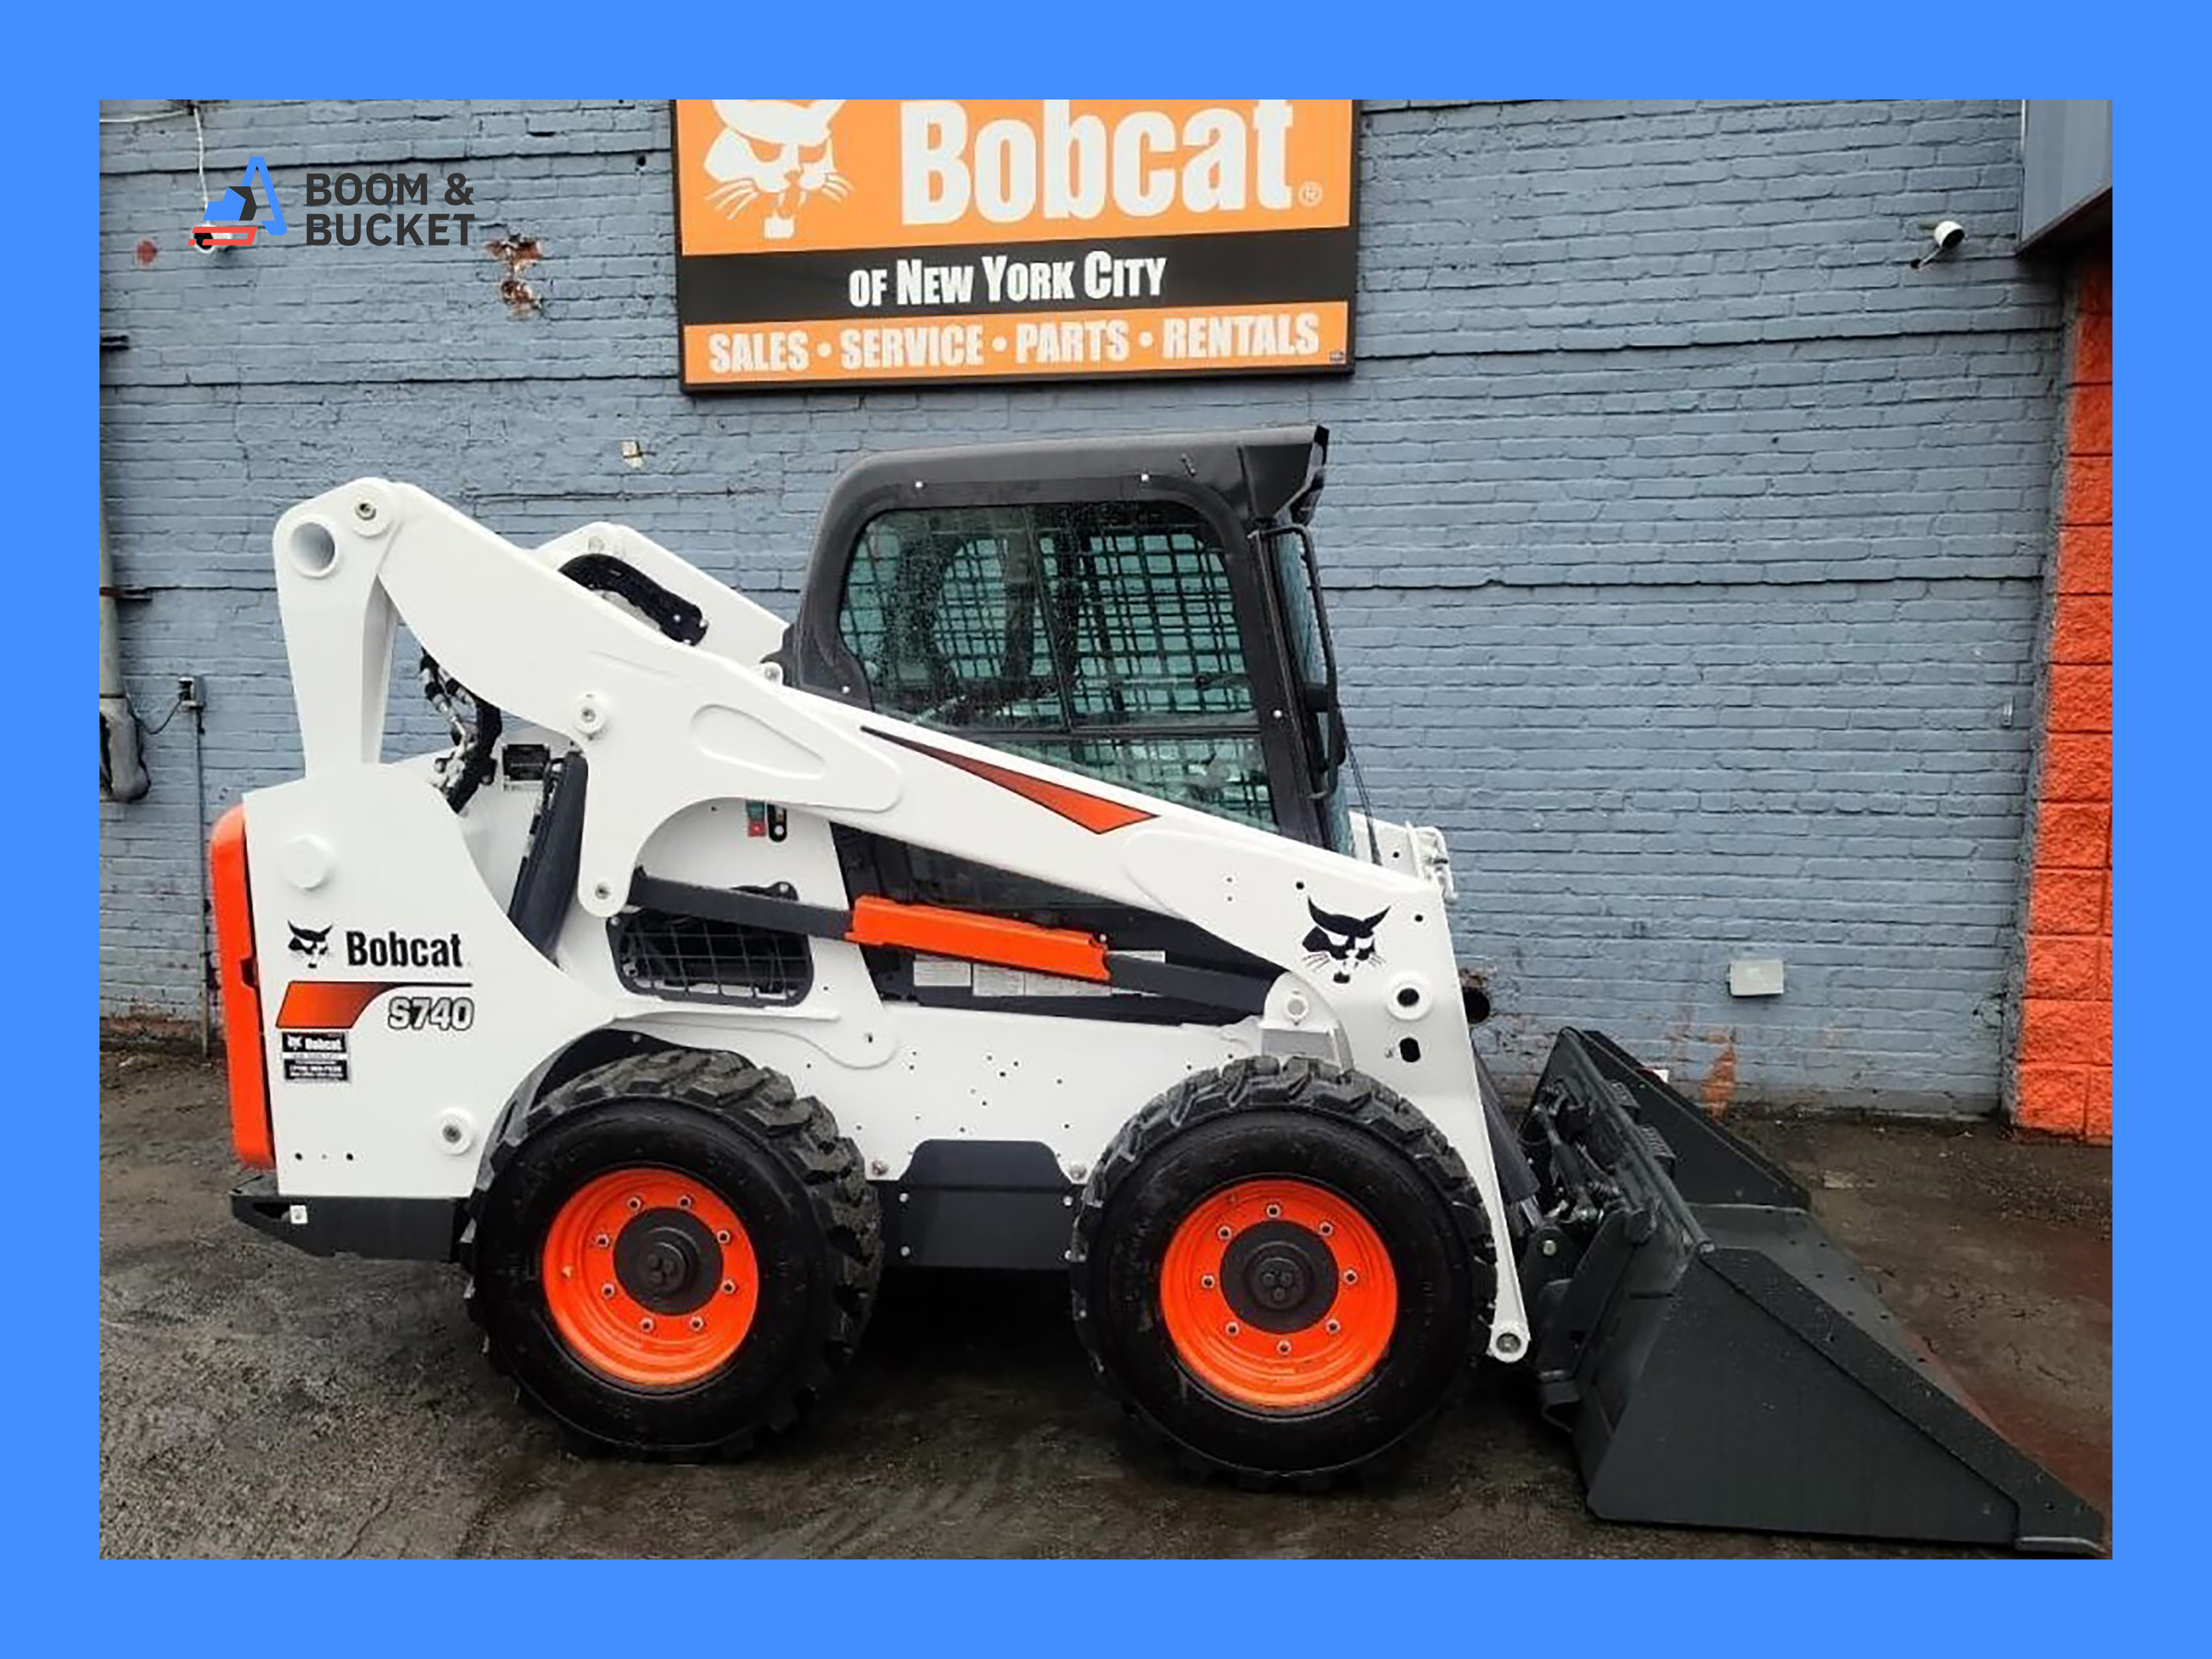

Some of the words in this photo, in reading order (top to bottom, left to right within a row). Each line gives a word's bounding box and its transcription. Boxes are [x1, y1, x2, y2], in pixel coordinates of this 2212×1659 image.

[901, 100, 1292, 225] Bobcat
[709, 332, 808, 372] SALES
[840, 324, 984, 369] SERVICE
[1016, 320, 1129, 364] PARTS
[1163, 313, 1319, 358] RENTALS
[346, 931, 462, 967] Bobcat
[388, 997, 474, 1030] S740
